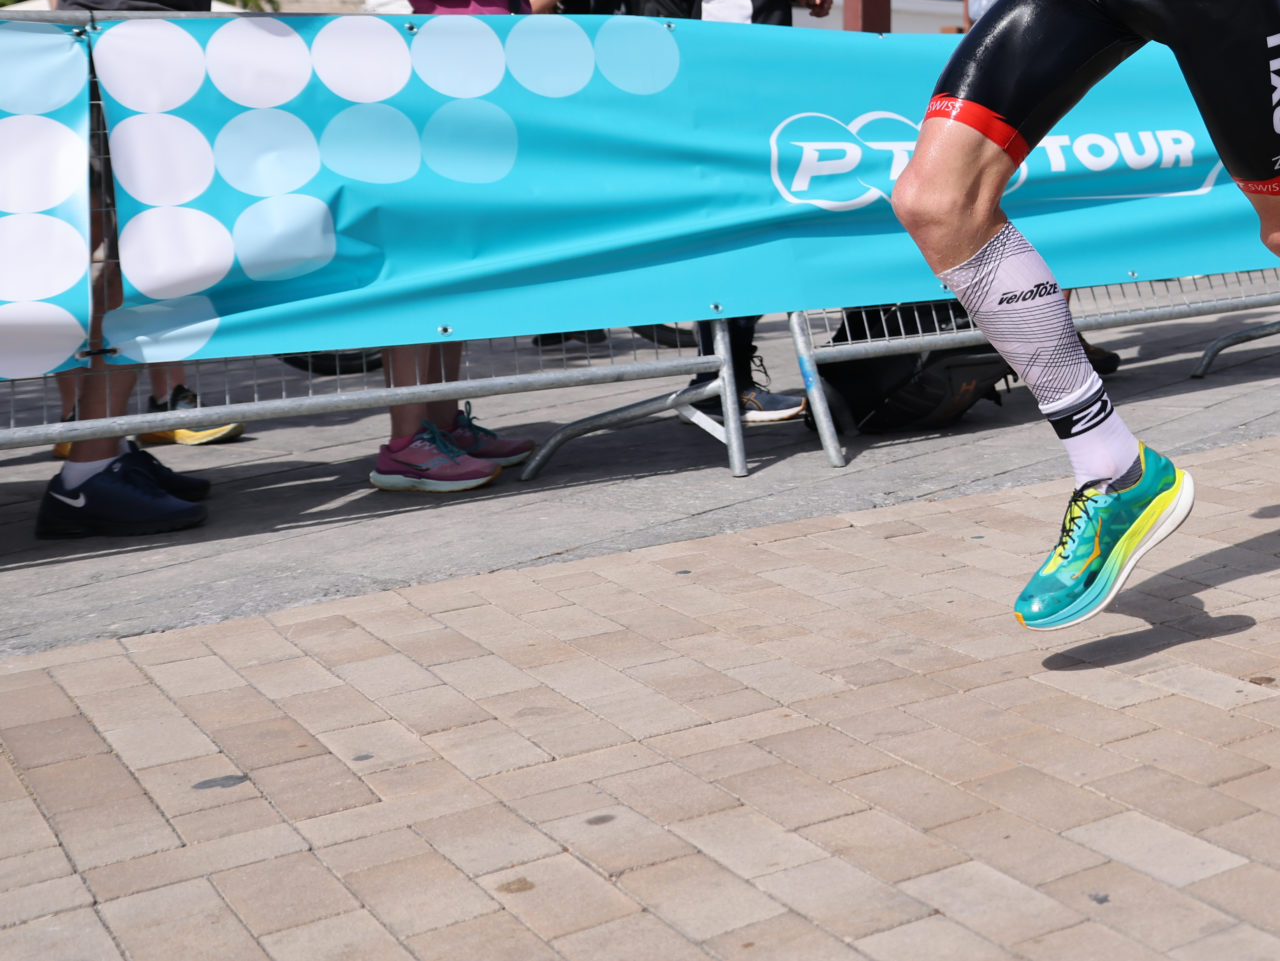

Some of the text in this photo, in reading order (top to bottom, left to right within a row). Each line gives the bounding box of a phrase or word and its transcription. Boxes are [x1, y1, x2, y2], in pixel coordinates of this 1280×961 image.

[928, 100, 964, 113] SWISS
[790, 129, 1196, 192] PT TOUR
